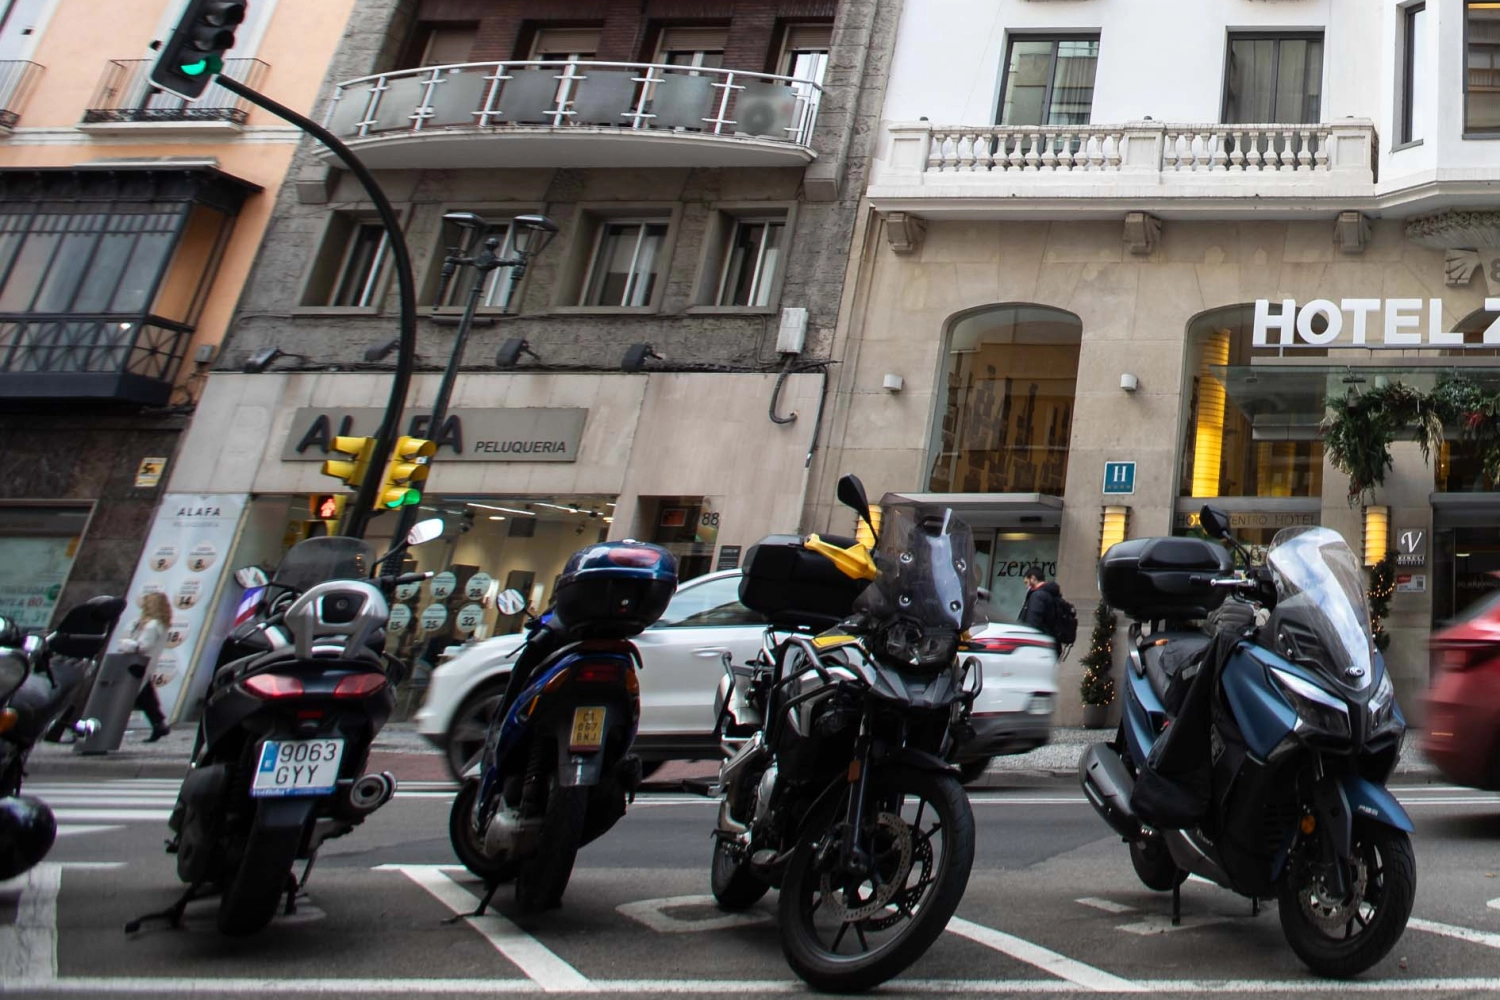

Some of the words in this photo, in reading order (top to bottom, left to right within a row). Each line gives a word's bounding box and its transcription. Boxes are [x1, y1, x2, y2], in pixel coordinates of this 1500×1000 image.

[1253, 298, 1464, 346] HOTEL
[474, 441, 566, 453] PELUQUERIA
[1113, 465, 1127, 482] H
[176, 507, 221, 517] ALAFA
[702, 513, 719, 525] 88
[1275, 515, 1318, 526] HOTEL
[280, 743, 337, 763] 9063
[275, 765, 318, 785] GYY
